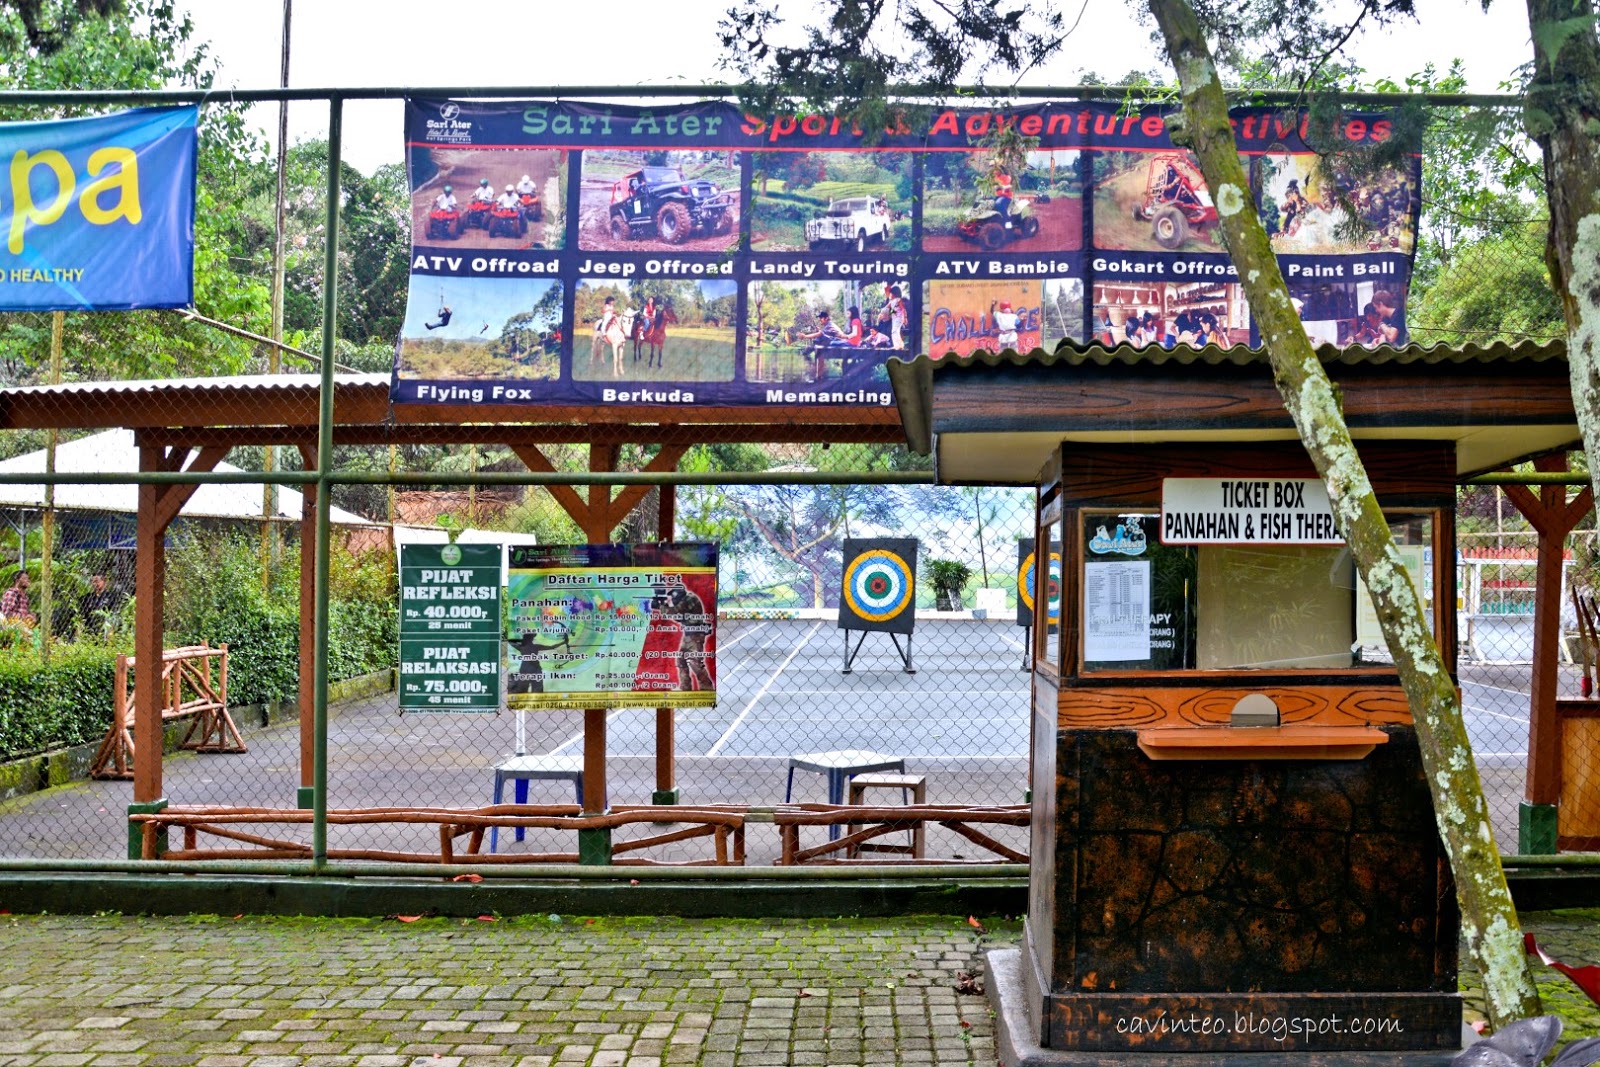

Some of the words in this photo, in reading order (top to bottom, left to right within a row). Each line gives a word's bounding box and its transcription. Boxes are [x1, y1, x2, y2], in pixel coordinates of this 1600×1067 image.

[426, 119, 448, 129] Sari
[450, 119, 472, 129] Ater
[522, 106, 613, 135] Sari
[631, 111, 723, 136] Ater
[928, 109, 1164, 137] Adventure
[0, 146, 142, 255] pa
[413, 255, 463, 271] ATV
[471, 257, 559, 273] Offroad
[578, 260, 636, 277] Jeep
[645, 260, 733, 275] Offroad
[750, 260, 816, 277] Landy
[824, 260, 908, 277] Touring
[935, 260, 980, 274] ATV
[989, 260, 1069, 274] Bambie
[1092, 258, 1164, 274] Gokart
[1172, 261, 1239, 276] Offroa
[1288, 263, 1344, 277] Paint
[1353, 261, 1395, 276] Ball
[10, 268, 84, 282] HEALTHY
[417, 385, 484, 402] Flying
[492, 385, 532, 400] Fox
[603, 388, 695, 403] Berkuda
[766, 389, 892, 405] Memancing
[1221, 481, 1270, 508] TICKET
[1274, 481, 1305, 508] BOX
[1165, 513, 1239, 539] PANAHAN
[1244, 513, 1255, 540] &
[1261, 513, 1292, 539] FISH
[1296, 514, 1343, 540] THERA
[421, 570, 473, 584] PIJAT
[549, 575, 592, 584] Daftar
[598, 574, 639, 586] Harga
[645, 574, 682, 583] Tiket
[403, 586, 497, 600] REFLEKSI
[512, 598, 573, 607] Panahan:
[406, 609, 421, 618] Rp.
[428, 621, 442, 630] 25
[443, 621, 472, 630] menit
[423, 647, 470, 660] PIJAT
[511, 653, 549, 661] Tembak
[553, 653, 588, 661] Target:
[401, 662, 497, 674] RELAKSASI
[514, 673, 546, 681] Terapi
[406, 683, 421, 692] Rp.
[428, 696, 442, 704] 45
[443, 695, 471, 704] menit
